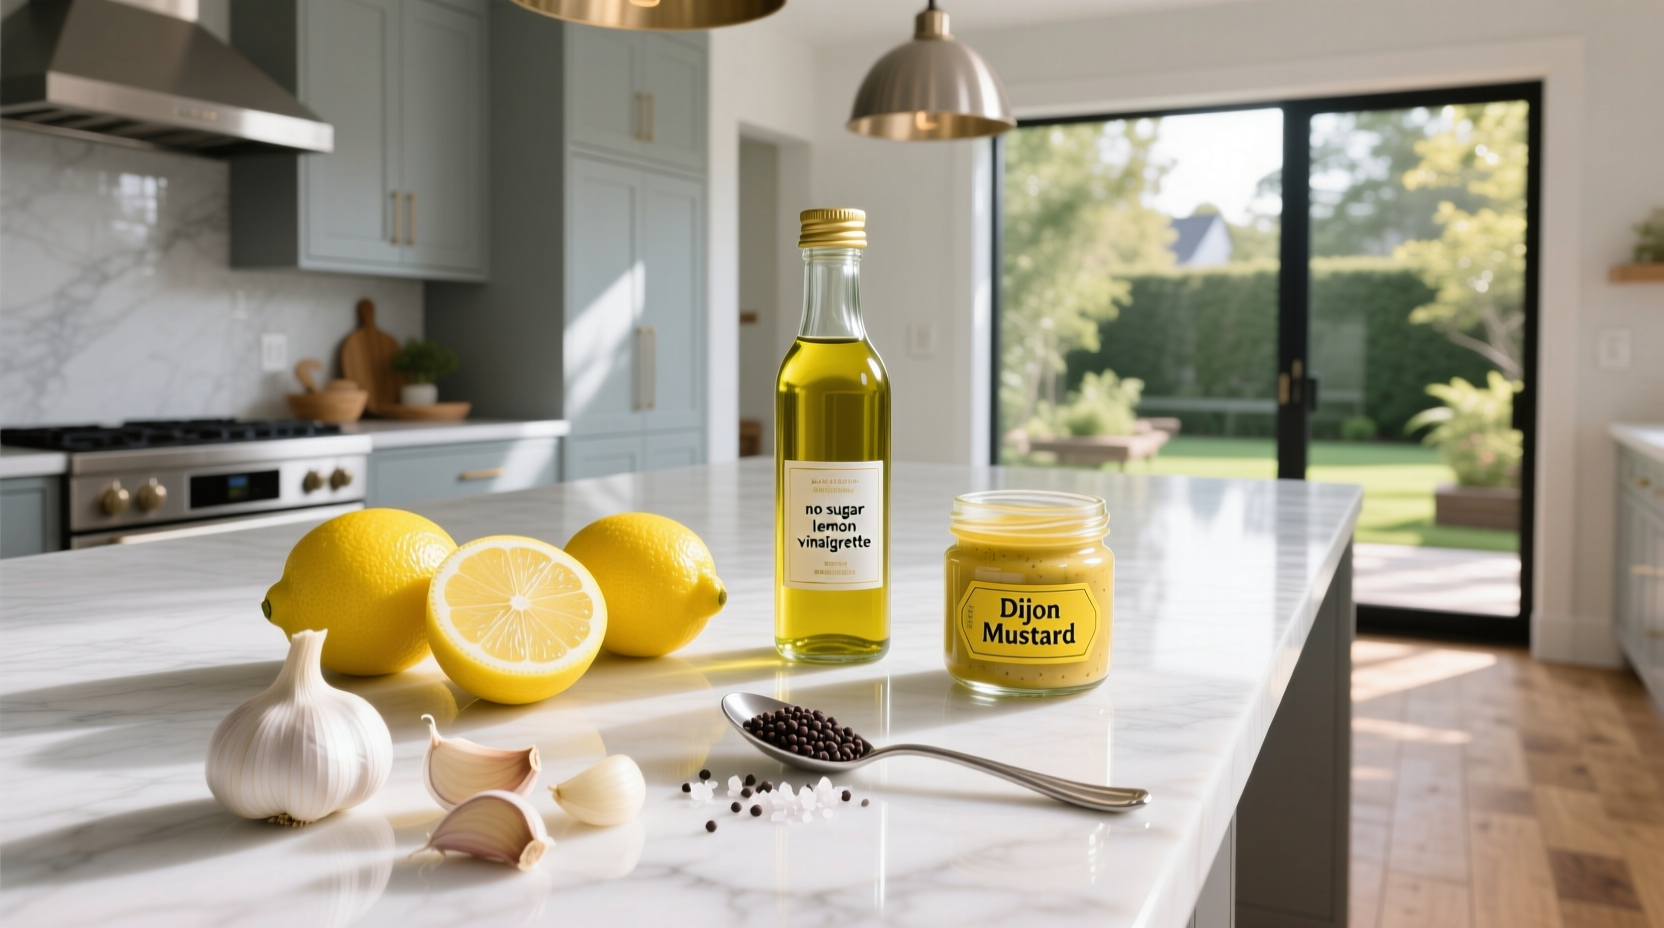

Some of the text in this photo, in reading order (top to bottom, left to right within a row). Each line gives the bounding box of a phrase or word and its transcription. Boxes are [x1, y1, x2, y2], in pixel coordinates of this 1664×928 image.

[806, 505, 865, 520] no sugar
[813, 519, 857, 533] lemon
[1000, 597, 1060, 625] Dijon
[983, 621, 1076, 645] Mustard
